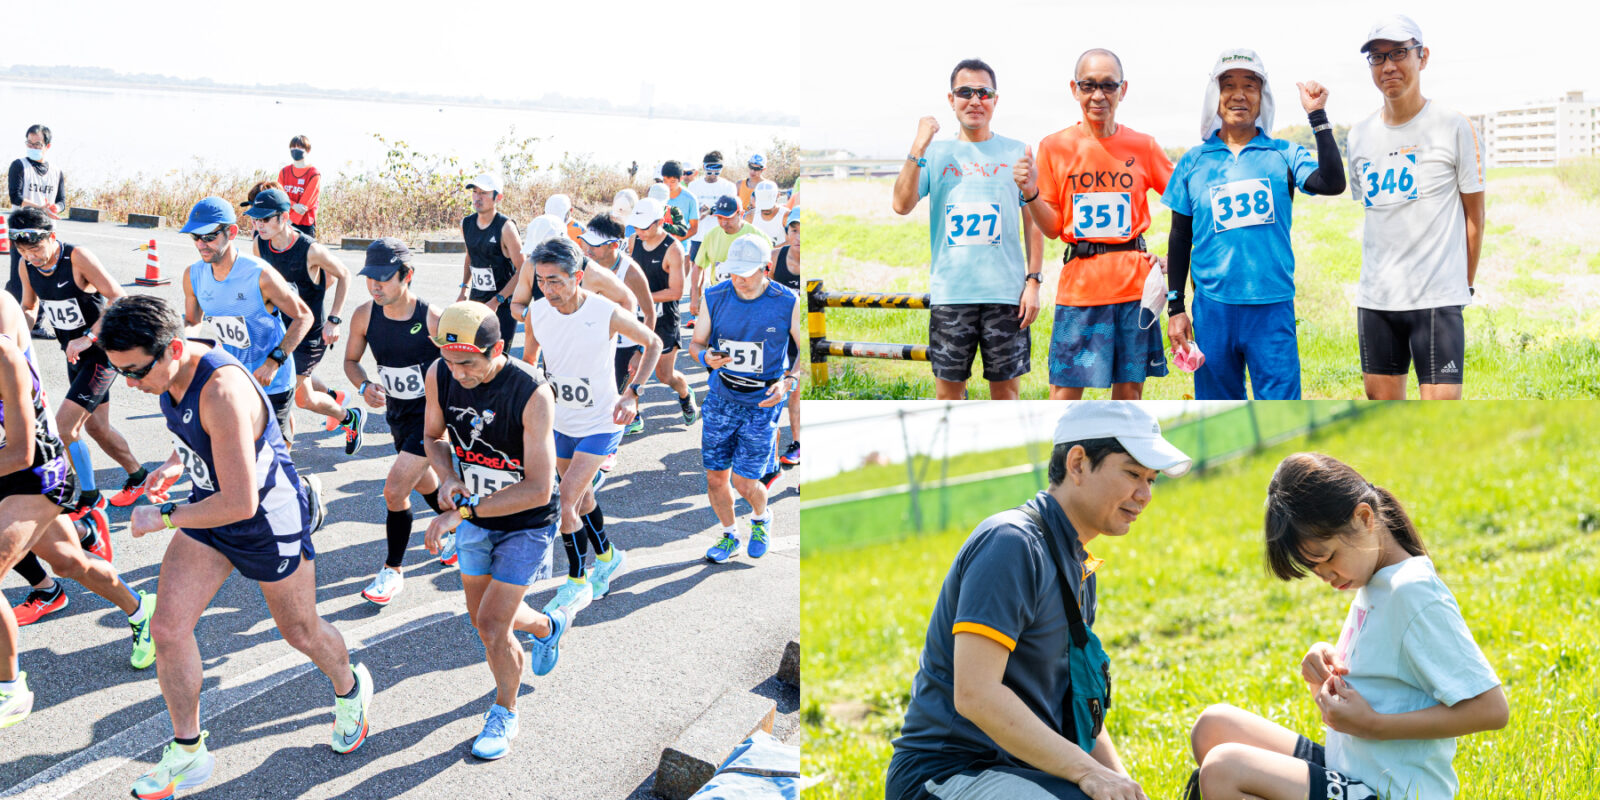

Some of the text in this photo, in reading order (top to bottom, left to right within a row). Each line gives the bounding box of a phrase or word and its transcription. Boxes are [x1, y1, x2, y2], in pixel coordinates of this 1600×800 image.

[1067, 171, 1133, 190] TOKYO
[1366, 166, 1414, 199] 346
[1077, 203, 1125, 230] 351
[1217, 190, 1270, 222] 338
[950, 213, 998, 238] 327
[473, 272, 493, 287] 163
[48, 306, 79, 324] 145
[216, 322, 245, 342] 166
[384, 374, 420, 393] 168
[552, 381, 589, 403] 180
